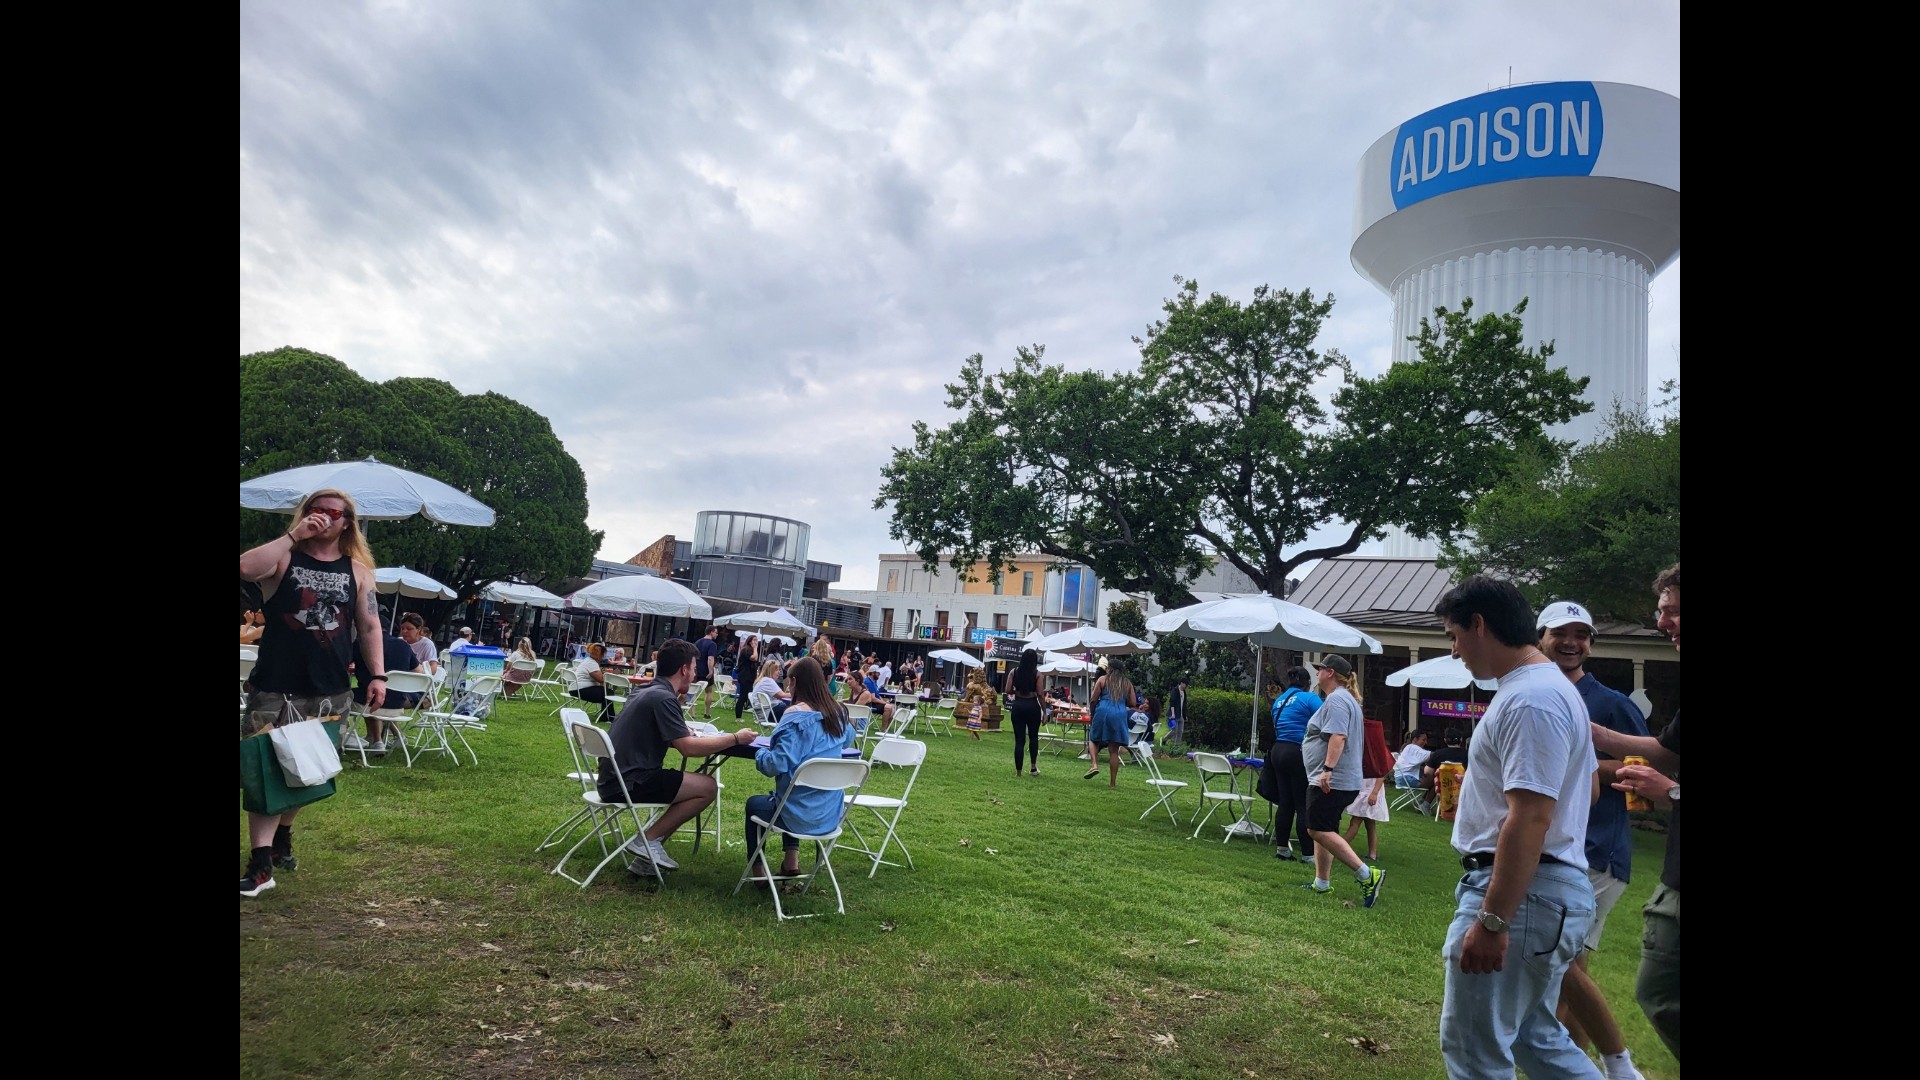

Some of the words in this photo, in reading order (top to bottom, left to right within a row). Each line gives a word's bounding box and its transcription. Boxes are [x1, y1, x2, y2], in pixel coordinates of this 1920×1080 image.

[1397, 100, 1590, 192] ADDISON
[1566, 605, 1580, 616] NY
[469, 661, 496, 671] green
[1427, 701, 1453, 711] TASTE
